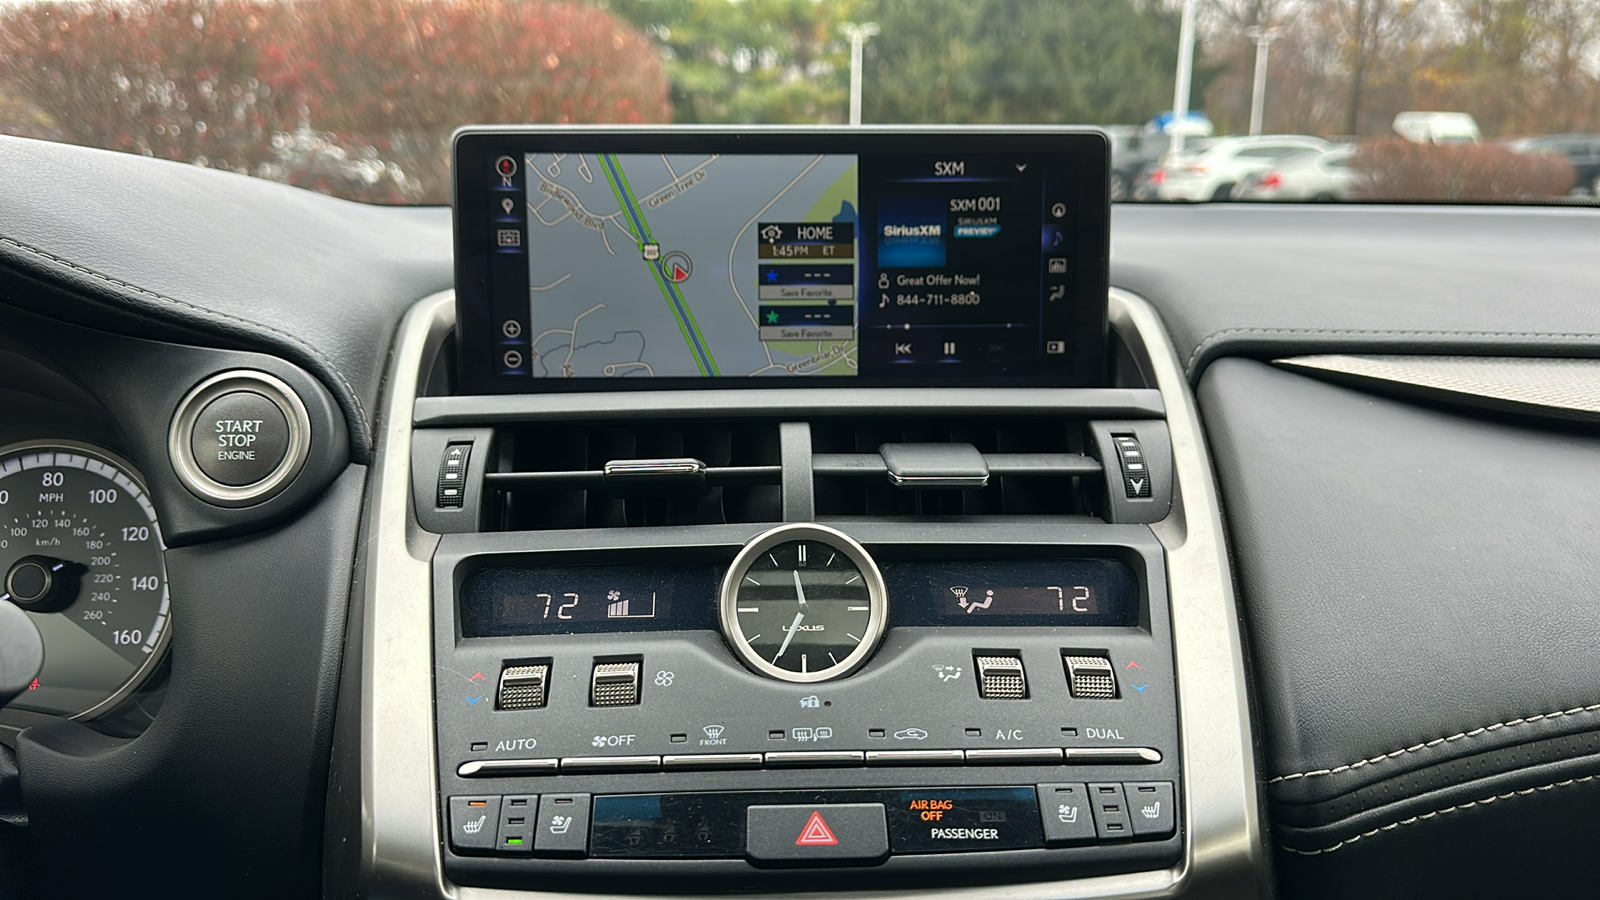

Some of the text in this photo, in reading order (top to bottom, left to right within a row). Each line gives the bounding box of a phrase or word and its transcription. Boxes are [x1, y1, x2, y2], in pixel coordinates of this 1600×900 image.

[934, 161, 965, 177] SXM
[502, 176, 512, 187] N
[648, 171, 706, 209] Green Tree Dr
[539, 181, 605, 231] Bridlewood Blvd
[949, 196, 1001, 212] SXM 001
[797, 226, 834, 240] HOME
[883, 224, 942, 237] SiriusXM
[822, 245, 835, 256] ET
[896, 274, 981, 287] Great Offer Now!
[780, 288, 833, 297] Save Favorite
[896, 293, 981, 306] 844-711-8800
[781, 329, 833, 338] Save Favorite
[786, 345, 845, 374] Greenbriar Dr
[215, 420, 263, 433] START
[218, 434, 257, 448] STOP
[217, 450, 256, 461] ENGINE
[42, 472, 64, 487] 80
[39, 493, 64, 503] MPH
[88, 489, 118, 504] 100
[31, 519, 49, 528] 120
[54, 519, 71, 528] 140
[10, 527, 28, 537] 100
[72, 527, 90, 537] 160
[121, 527, 150, 542] 120
[35, 537, 61, 546] km/h
[85, 540, 104, 550] 180
[90, 556, 111, 566] 200
[94, 574, 114, 584] 220
[131, 576, 159, 591] 140
[91, 592, 111, 602] 240
[1047, 585, 1090, 612] 72
[536, 593, 579, 620] 72
[83, 610, 104, 621] 260
[782, 624, 825, 632] LXUS
[112, 630, 142, 644] 160
[995, 729, 1024, 741] A/C
[1085, 728, 1125, 740] DUAL
[495, 738, 537, 752] AUTO
[607, 734, 636, 747] OFF
[700, 738, 727, 746] FRONT
[909, 800, 953, 810] AIR BAG
[920, 811, 943, 822] OFF
[931, 827, 999, 840] PASSENGER
